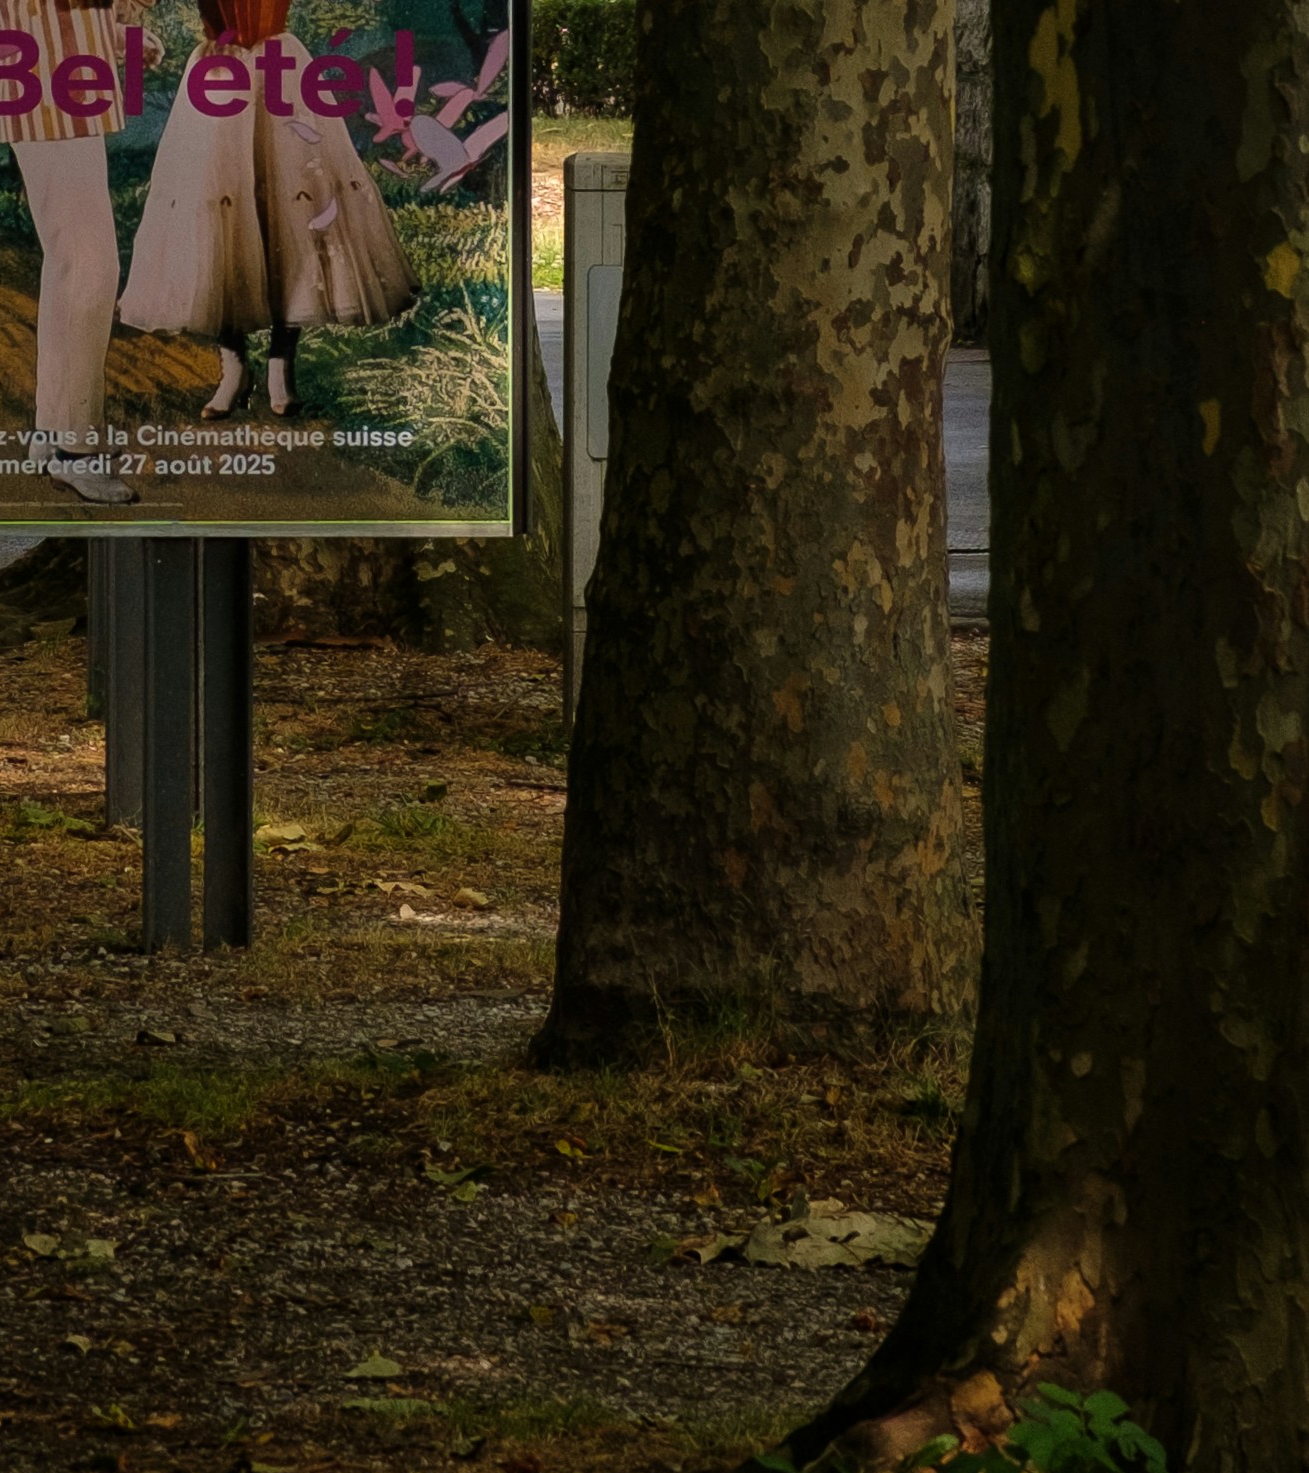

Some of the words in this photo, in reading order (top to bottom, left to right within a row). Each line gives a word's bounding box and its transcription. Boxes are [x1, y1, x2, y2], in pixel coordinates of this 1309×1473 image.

[85, 425, 99, 446] à
[107, 425, 129, 446] la
[136, 425, 325, 451] Cinémathèque
[332, 425, 414, 447] suisse
[118, 454, 147, 475] 27
[154, 454, 212, 475] août
[218, 454, 276, 475] 2025
